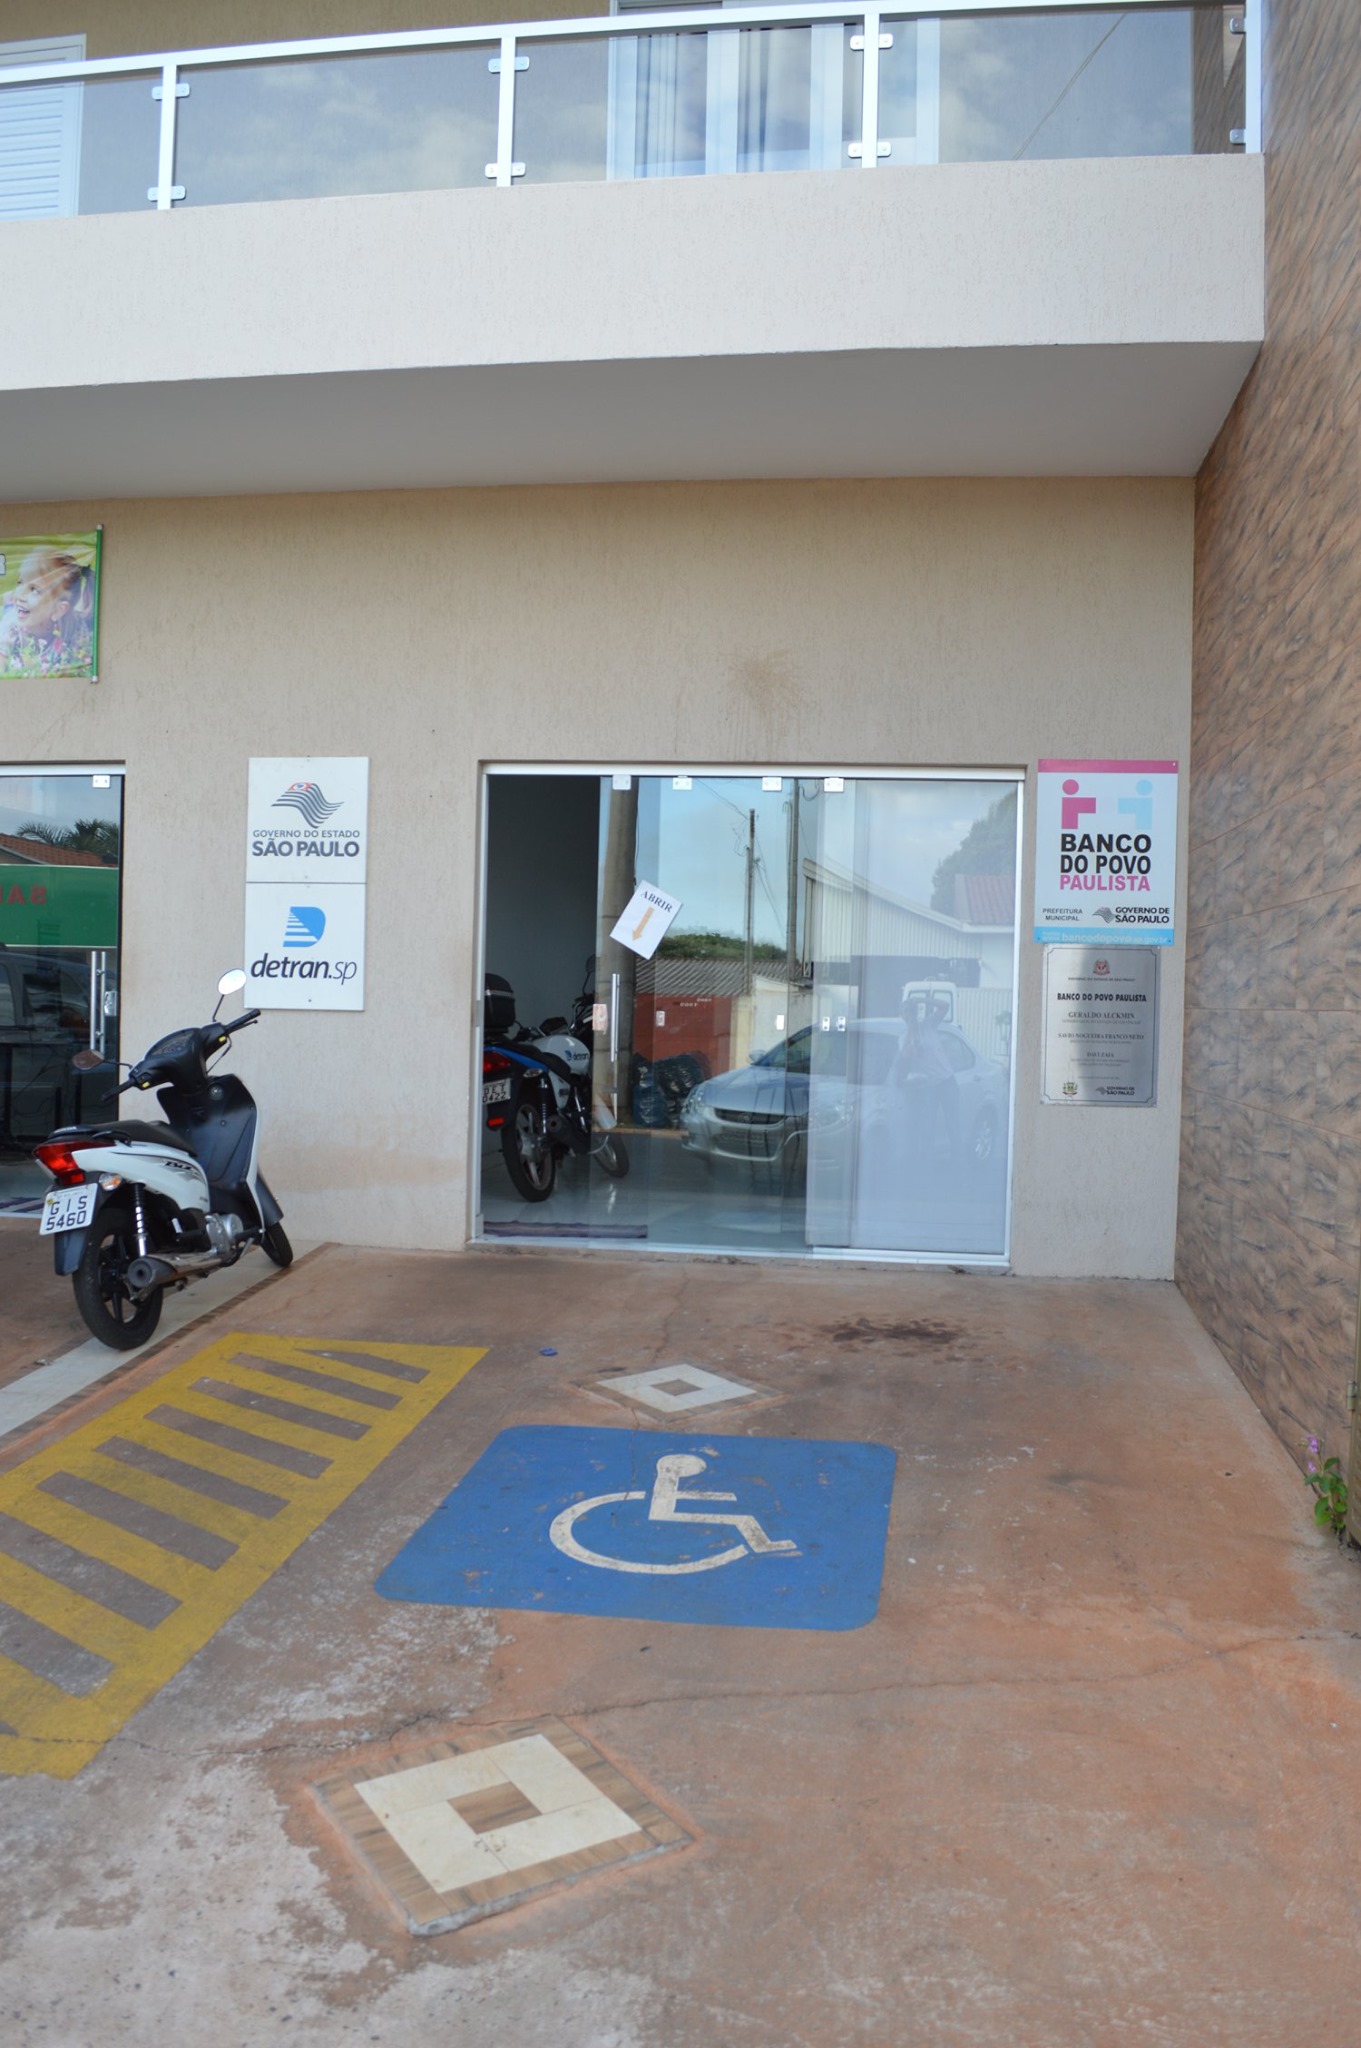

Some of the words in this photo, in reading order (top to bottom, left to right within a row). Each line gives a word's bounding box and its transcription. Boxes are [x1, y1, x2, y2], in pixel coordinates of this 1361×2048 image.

[252, 829, 301, 838] GOVERNO
[303, 829, 319, 838] DO
[321, 829, 360, 838] ESTADO
[1060, 833, 1152, 853] BANCO
[252, 837, 294, 857] SÃO
[296, 841, 360, 857] PAULO
[1060, 854, 1089, 874] DO
[1095, 855, 1152, 875] POVO
[1059, 874, 1151, 892] PAULISTA
[641, 891, 672, 912] ABRIR
[1115, 906, 1158, 914] GOVERNO
[1115, 913, 1137, 923] SÃO
[1137, 915, 1170, 924] PAULO
[250, 953, 357, 985] detran.sp
[1082, 993, 1092, 1001] DO
[1115, 994, 1147, 1002] PAULISTA
[45, 1210, 87, 1231] 5460
